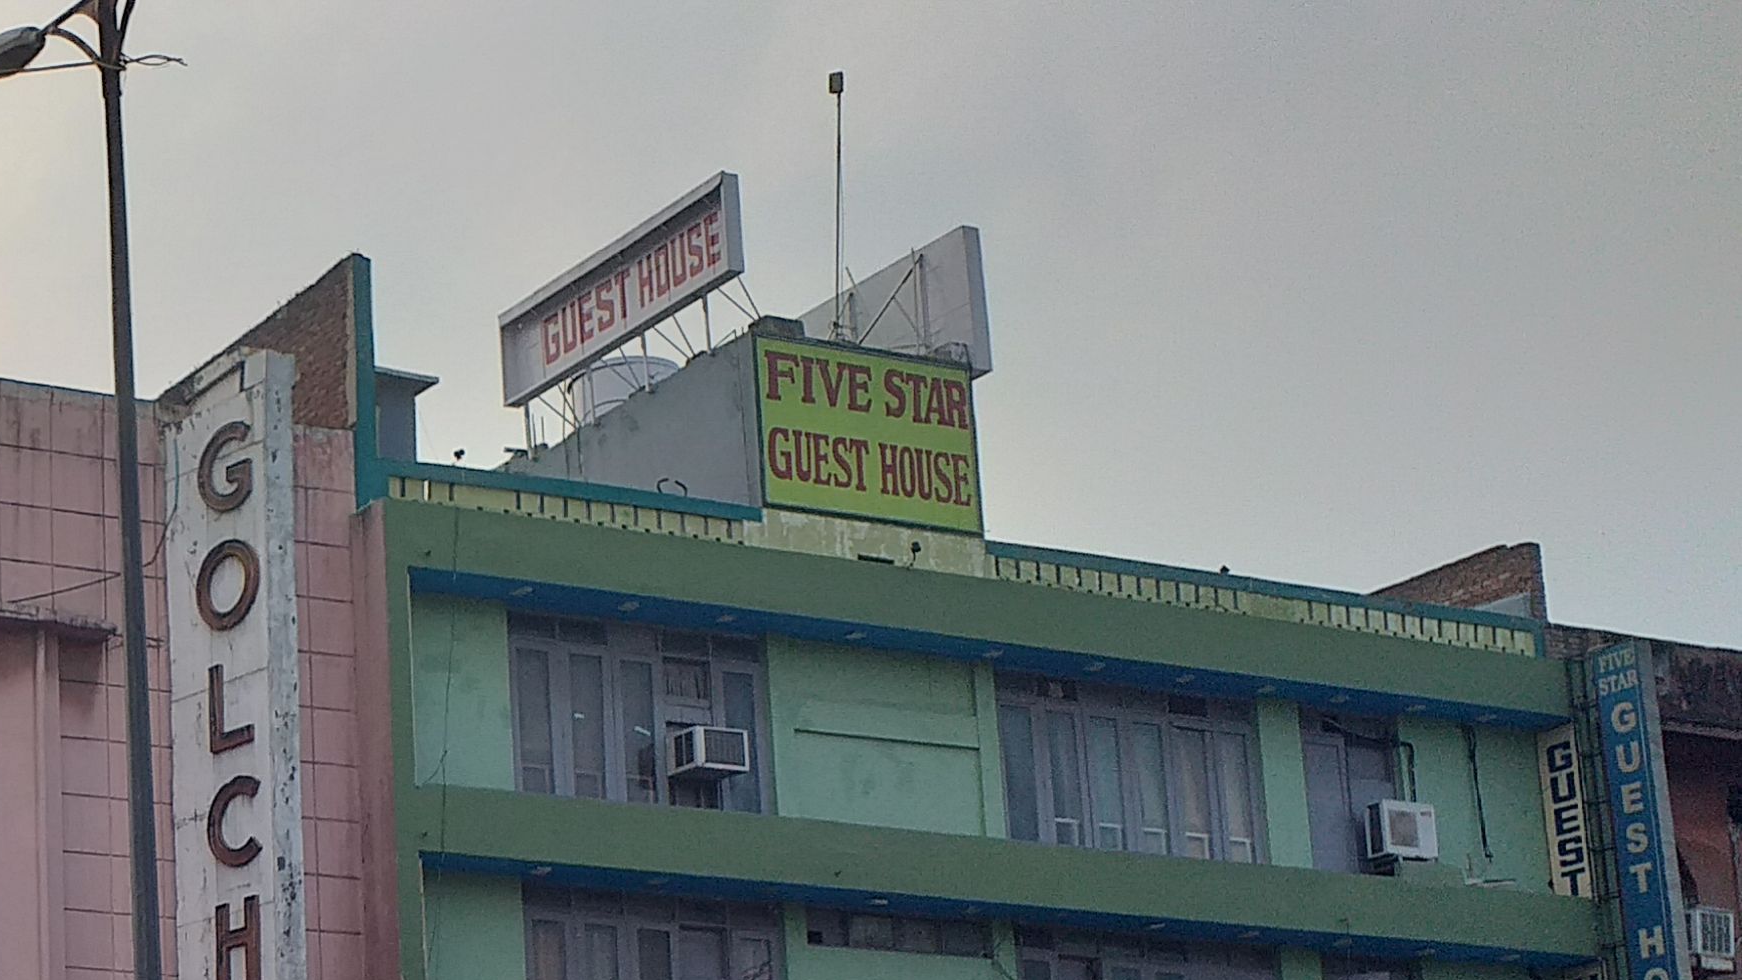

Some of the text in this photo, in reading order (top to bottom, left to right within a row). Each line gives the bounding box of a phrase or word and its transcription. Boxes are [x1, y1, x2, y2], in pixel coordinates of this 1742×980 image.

[541, 210, 722, 366] GUEST HOUSE
[763, 350, 969, 431] FIVE STAR
[767, 426, 971, 507] GUEST HOUSE
[1598, 651, 1635, 673] FIVE
[1598, 670, 1638, 696] STAR
[1546, 741, 1582, 898] GUEST
[1611, 702, 1651, 893] GUEST
